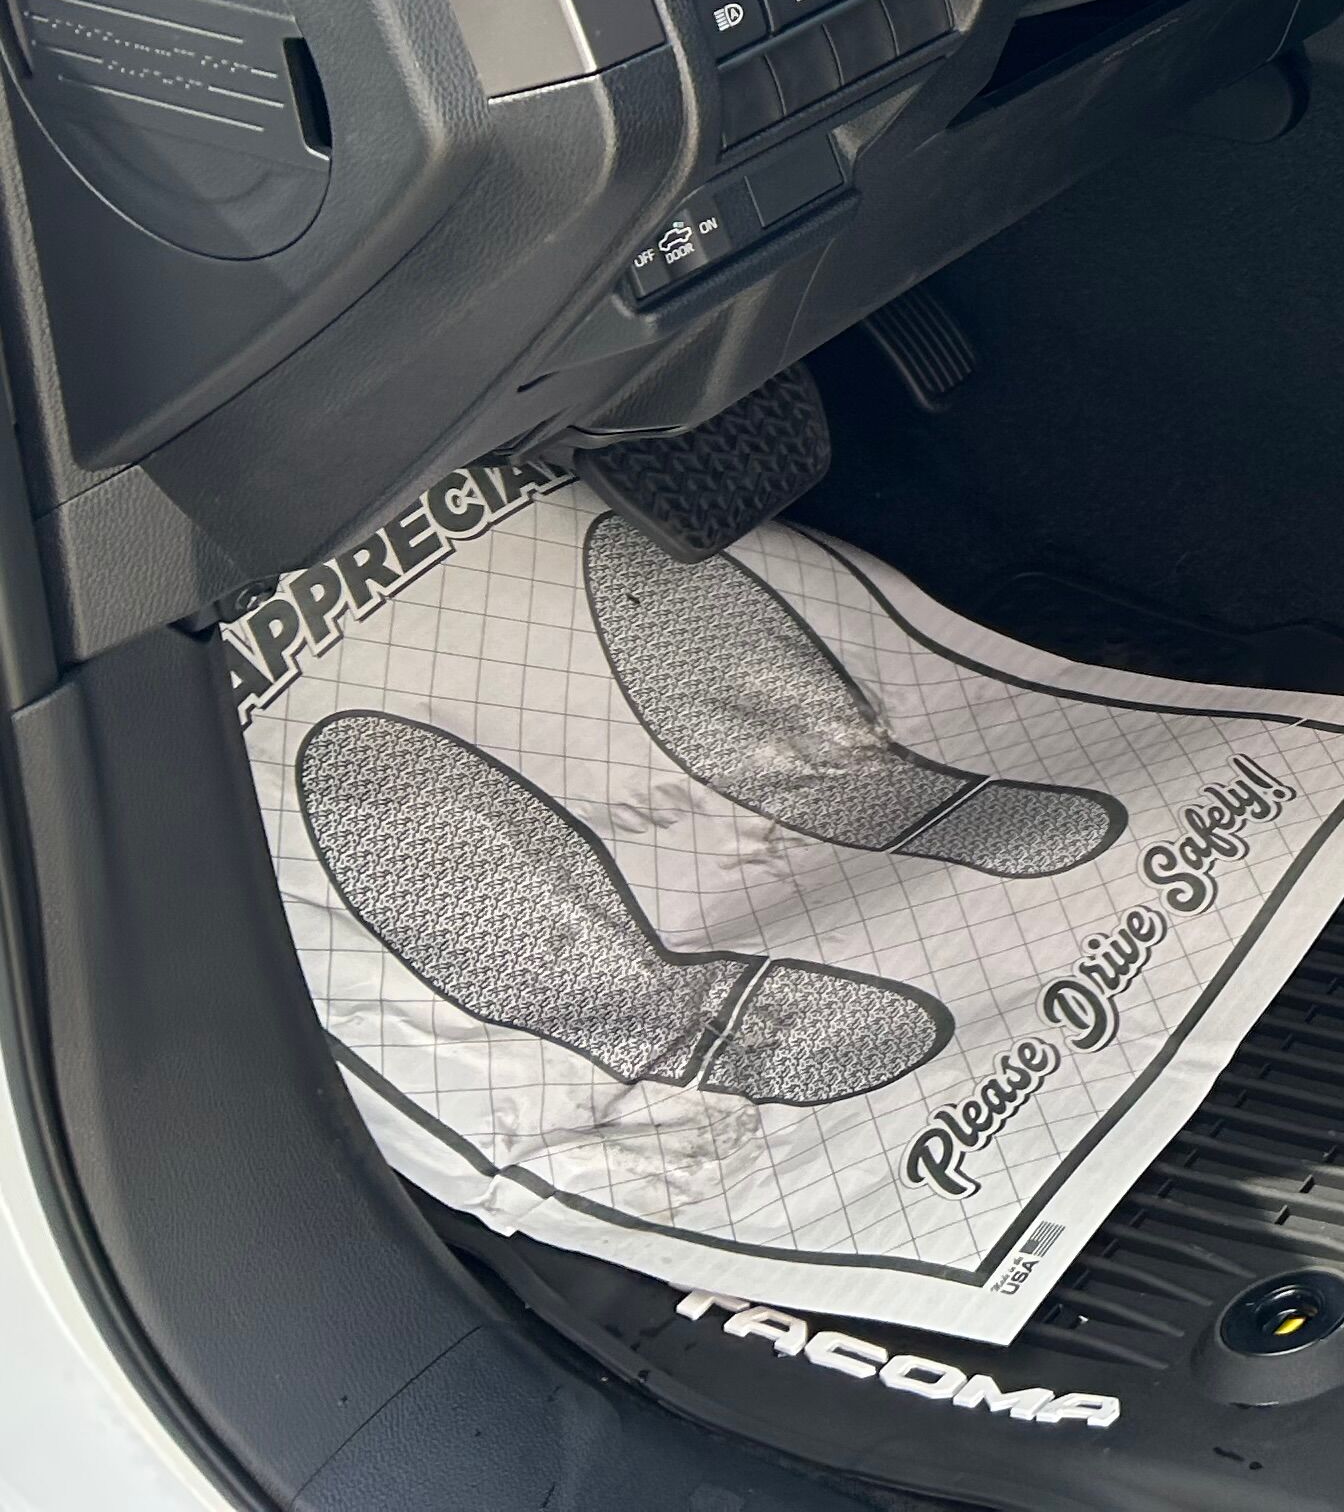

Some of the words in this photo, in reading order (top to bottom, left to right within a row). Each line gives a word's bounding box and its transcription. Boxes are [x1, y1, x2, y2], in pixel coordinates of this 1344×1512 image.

[698, 217, 718, 234] ON
[665, 242, 696, 265] DOOR
[902, 1038, 1057, 1198] Please
[1041, 906, 1163, 1050] Drive
[1142, 752, 1296, 916] Safely!
[1000, 1260, 1040, 1295] USA
[674, 1288, 1121, 1428] TACOMA
